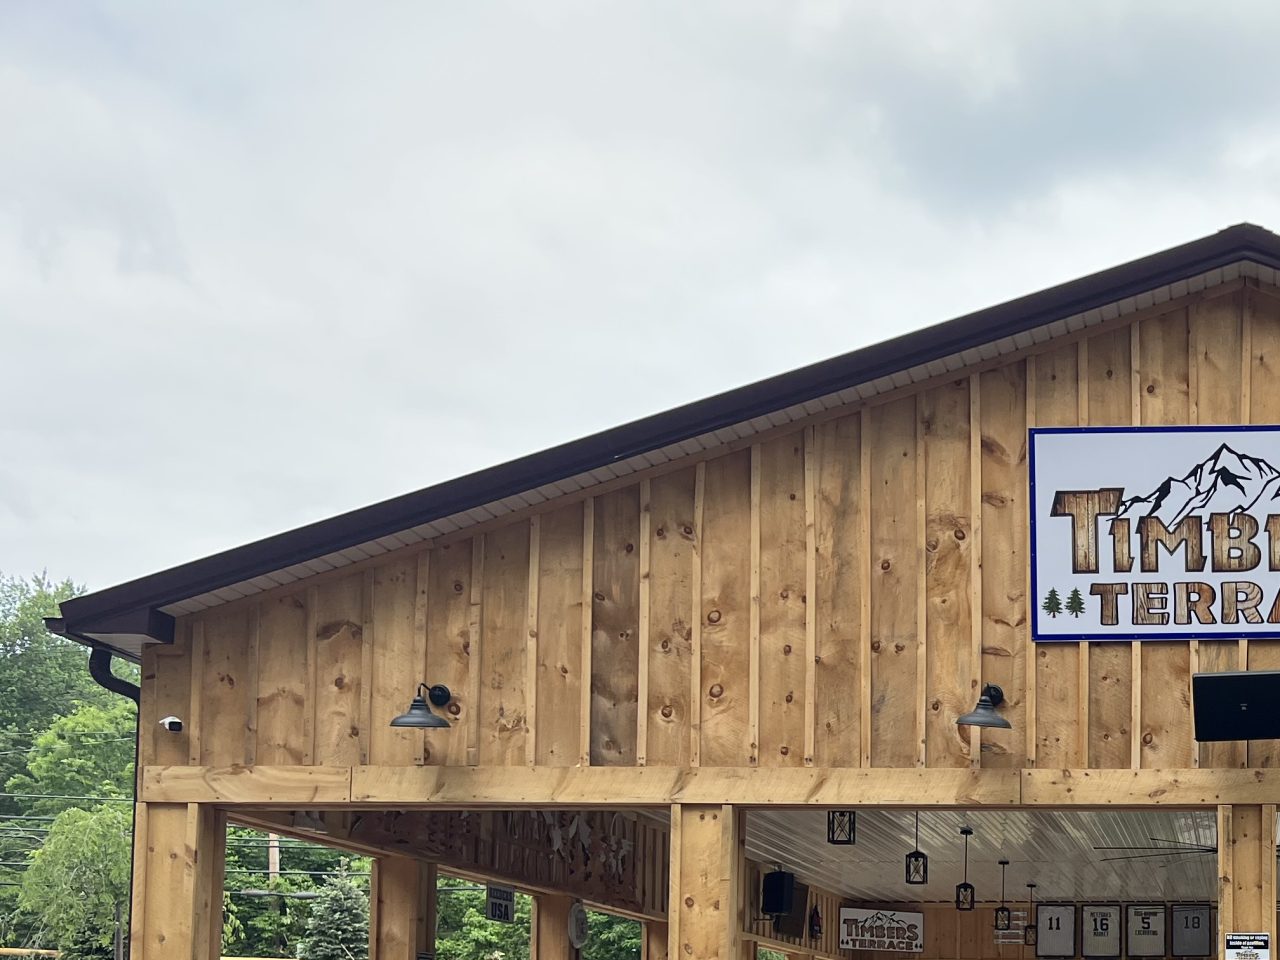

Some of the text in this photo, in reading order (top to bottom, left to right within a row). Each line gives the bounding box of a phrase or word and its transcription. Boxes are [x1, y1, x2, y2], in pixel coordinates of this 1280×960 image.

[491, 902, 509, 920] USA
[1048, 916, 1060, 930] 11
[1093, 917, 1109, 931] 16
[1141, 917, 1150, 929] 5
[1184, 916, 1200, 929] 18
[843, 919, 919, 941] TIMBERS
[850, 939, 914, 950] TERRACE
